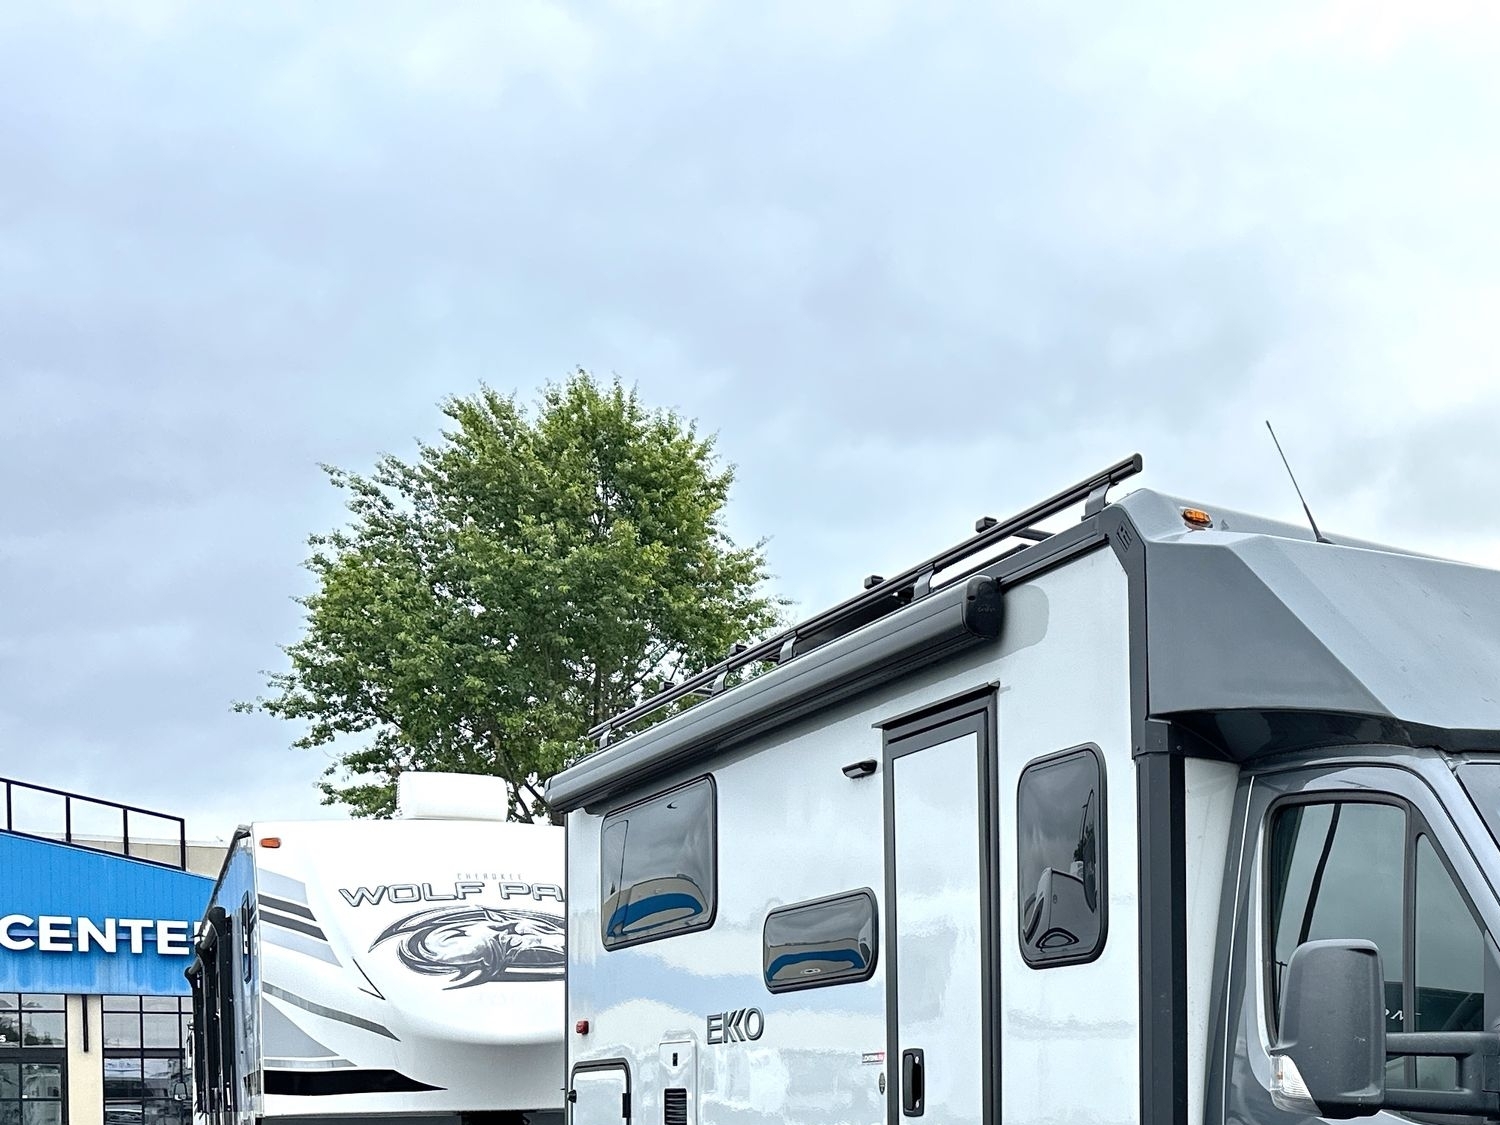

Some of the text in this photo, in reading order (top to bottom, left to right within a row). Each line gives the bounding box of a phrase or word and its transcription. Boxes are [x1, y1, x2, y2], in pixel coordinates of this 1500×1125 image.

[338, 882, 485, 907] WOLF
[0, 914, 204, 955] CENTE
[707, 1008, 764, 1045] EKKO
